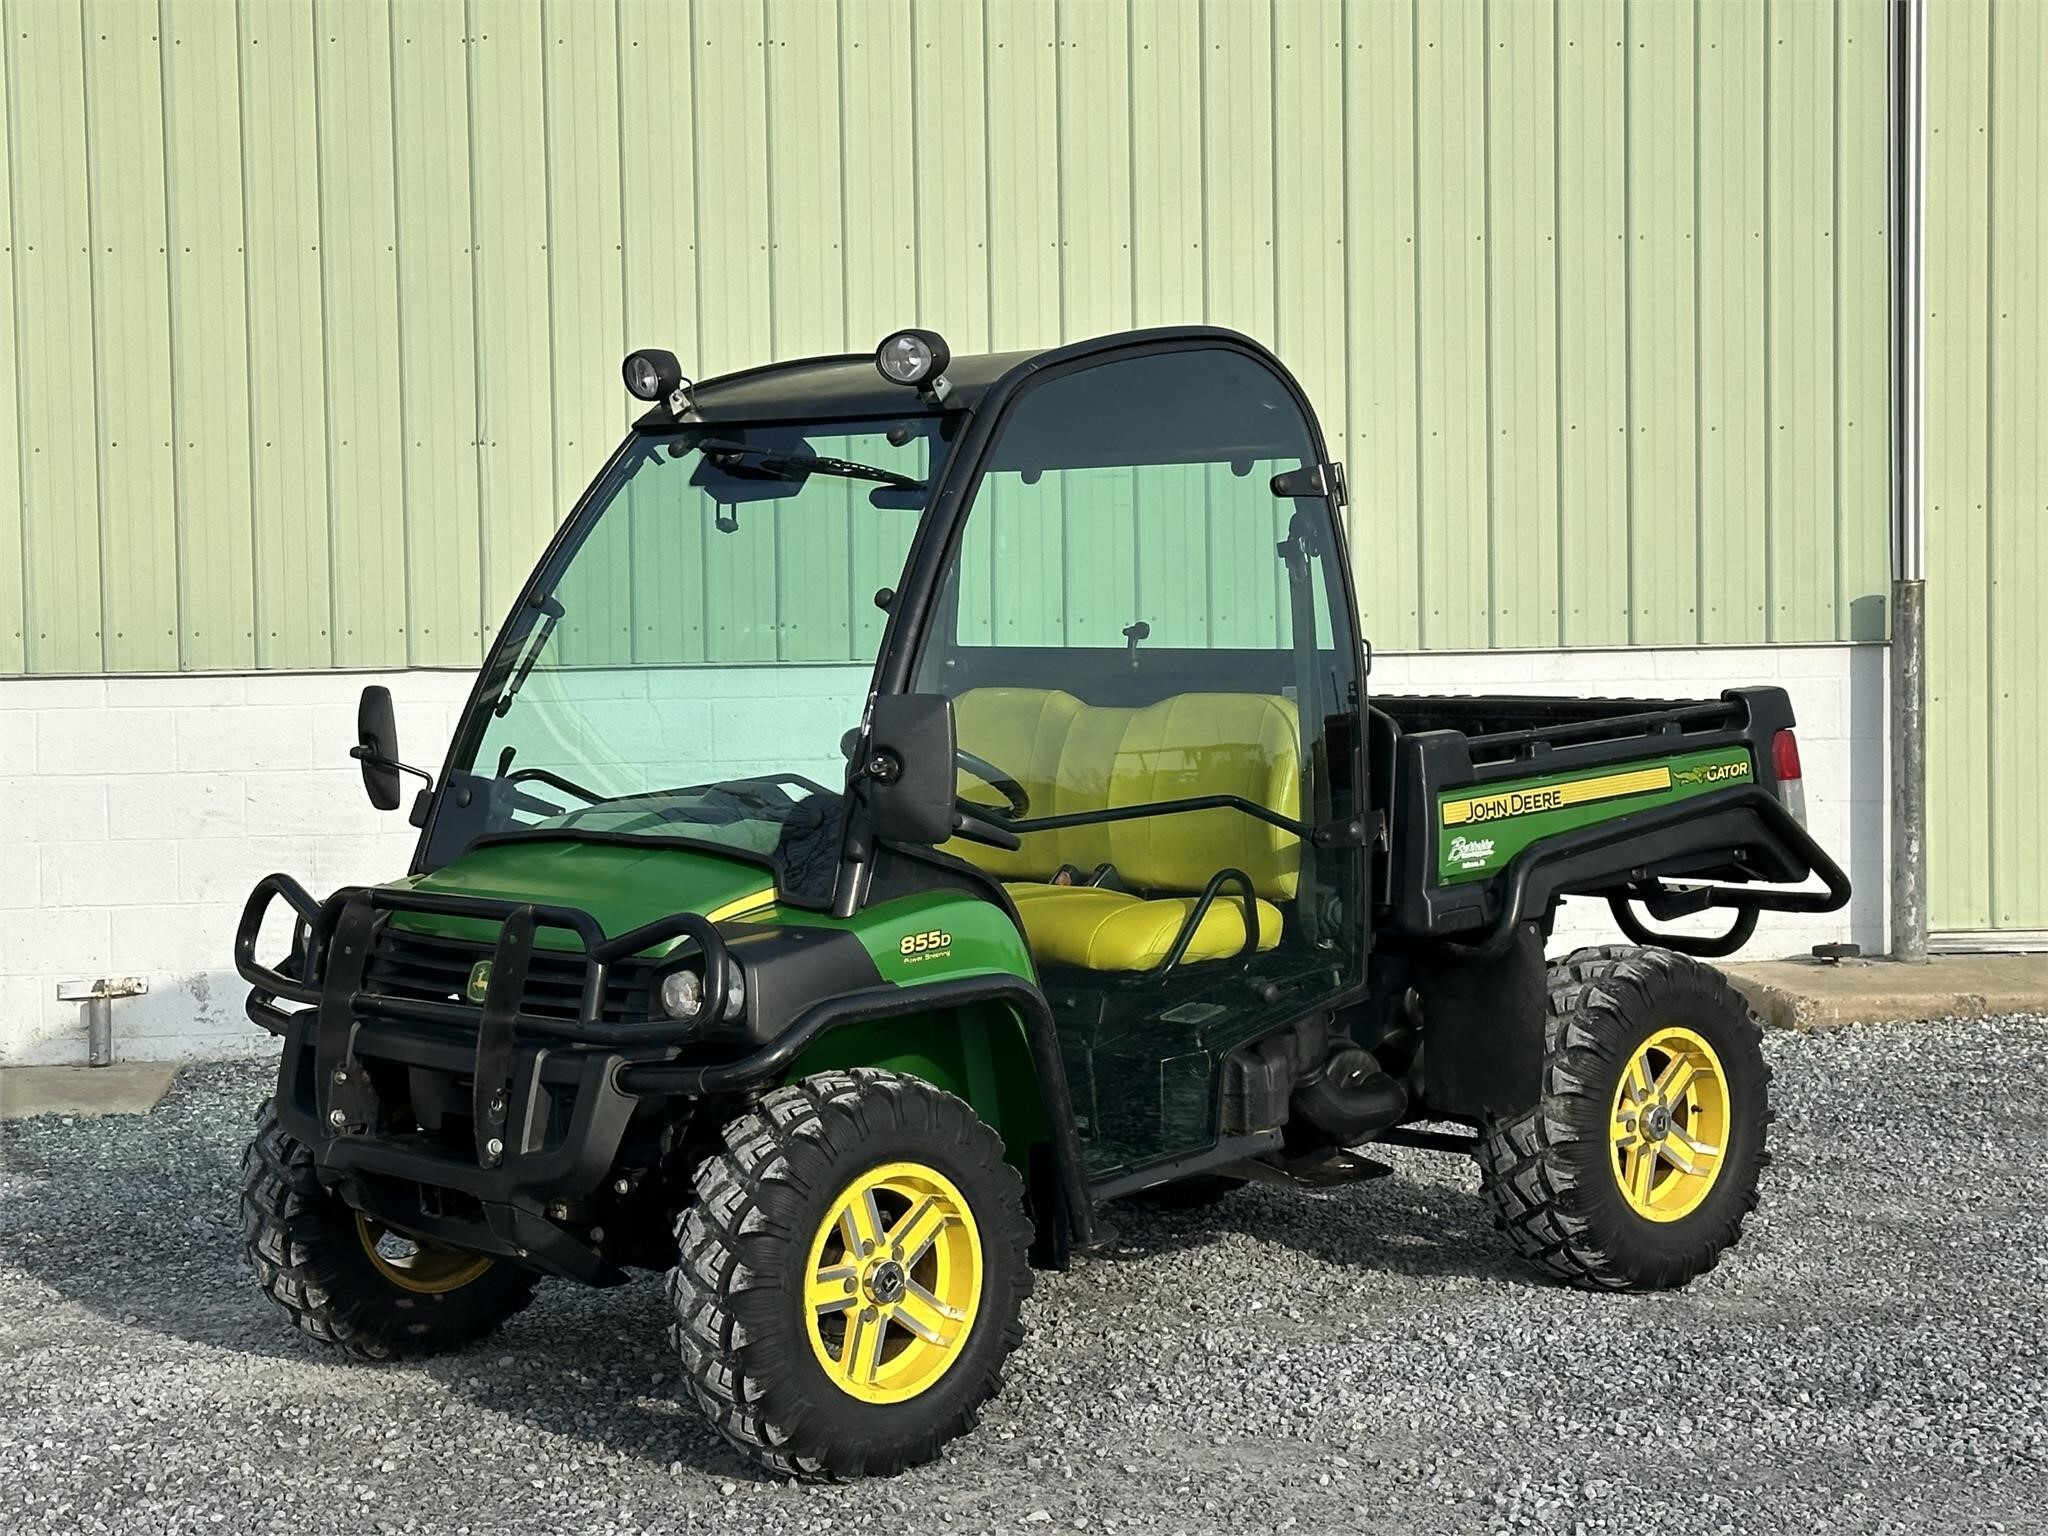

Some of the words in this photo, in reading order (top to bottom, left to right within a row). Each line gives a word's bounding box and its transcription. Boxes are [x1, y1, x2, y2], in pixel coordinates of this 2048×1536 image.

[1706, 762, 1748, 782] GATOR
[1465, 800, 1508, 822] JOHN
[1510, 790, 1563, 814] DEERE
[900, 930, 952, 955] 855D
